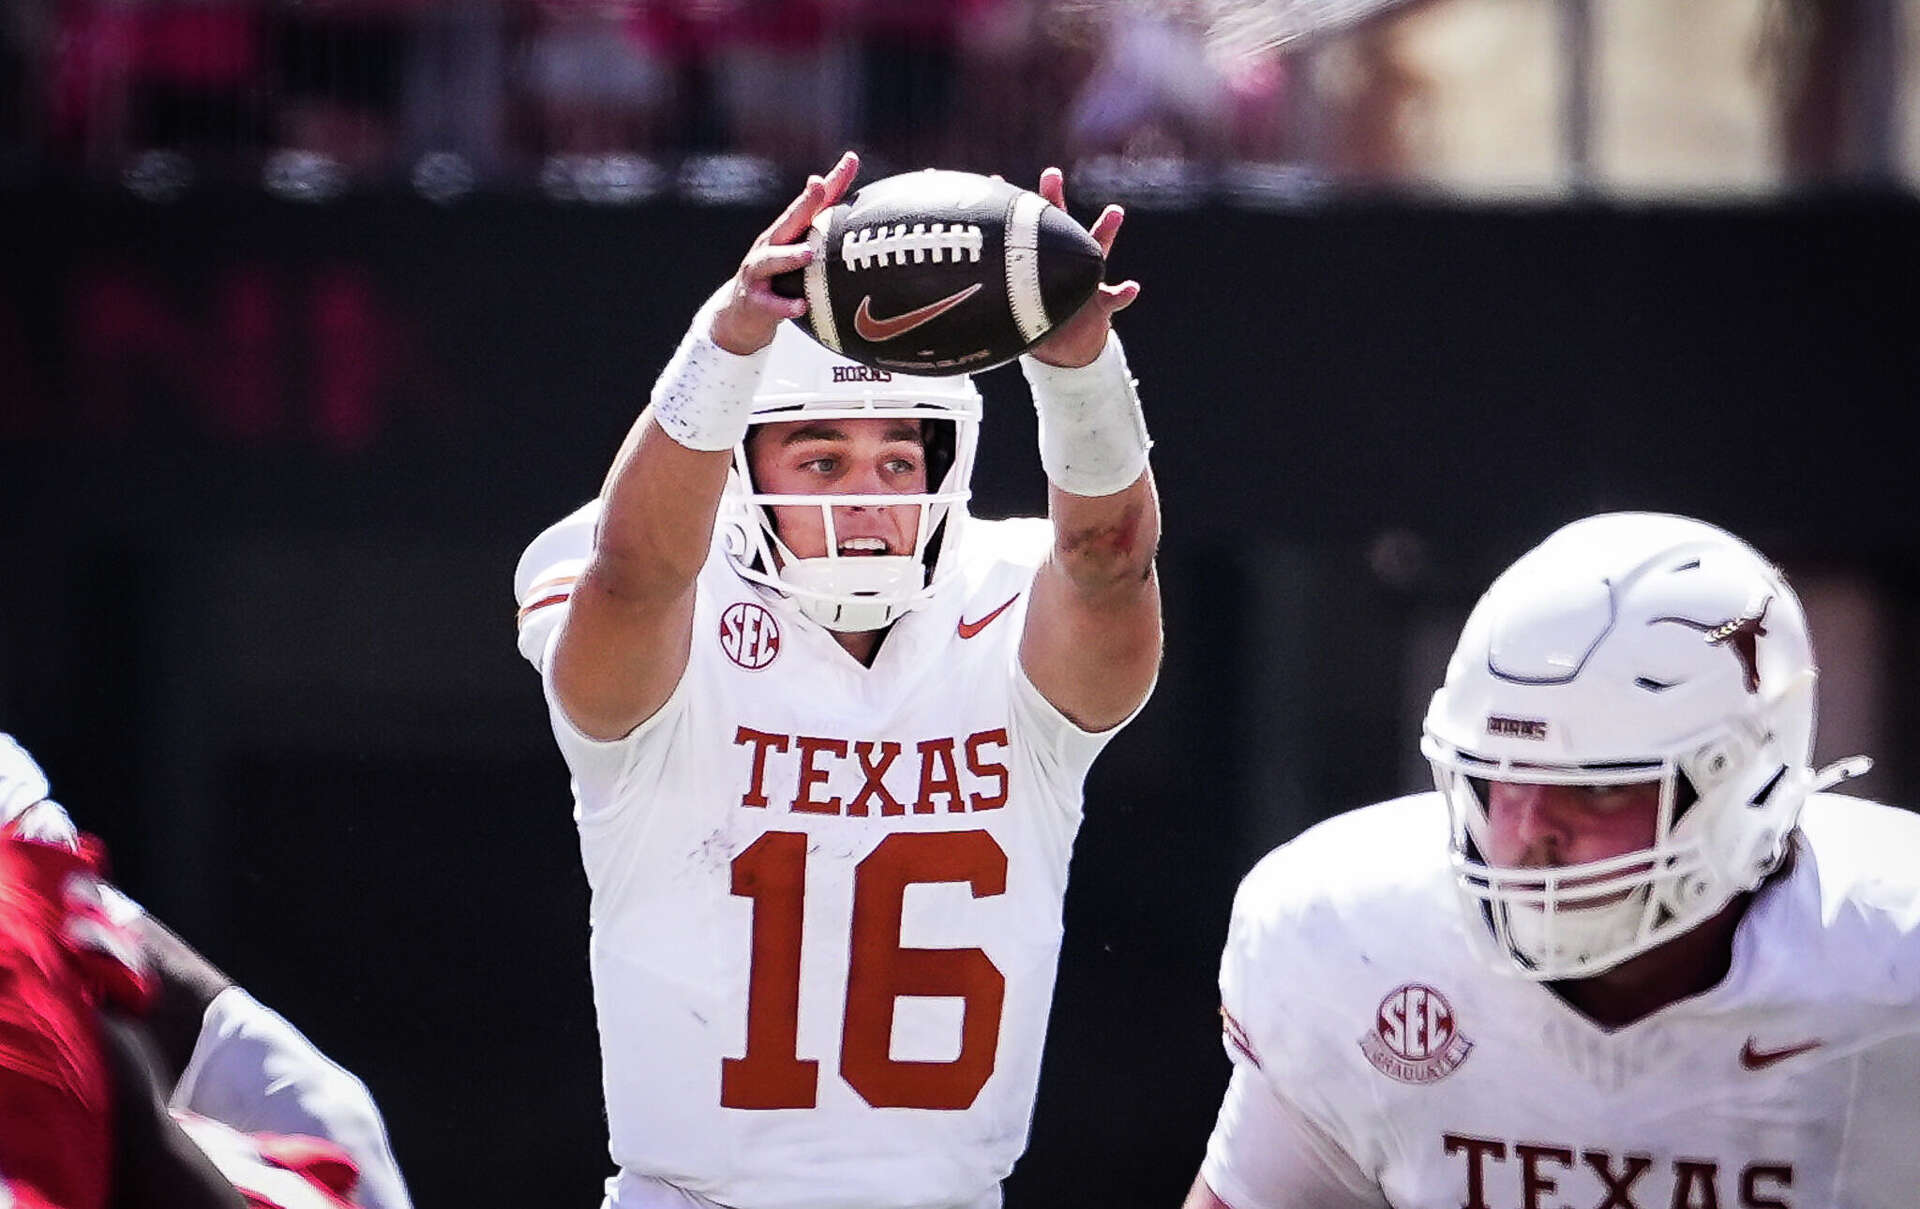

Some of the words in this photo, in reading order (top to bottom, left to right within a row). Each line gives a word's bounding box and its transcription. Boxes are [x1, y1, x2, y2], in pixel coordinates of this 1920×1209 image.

[832, 365, 892, 383] HORNS
[720, 602, 780, 670] SEC
[734, 725, 1009, 817] TEXAS
[720, 829, 1008, 1110] 16
[1377, 984, 1455, 1060] SEC
